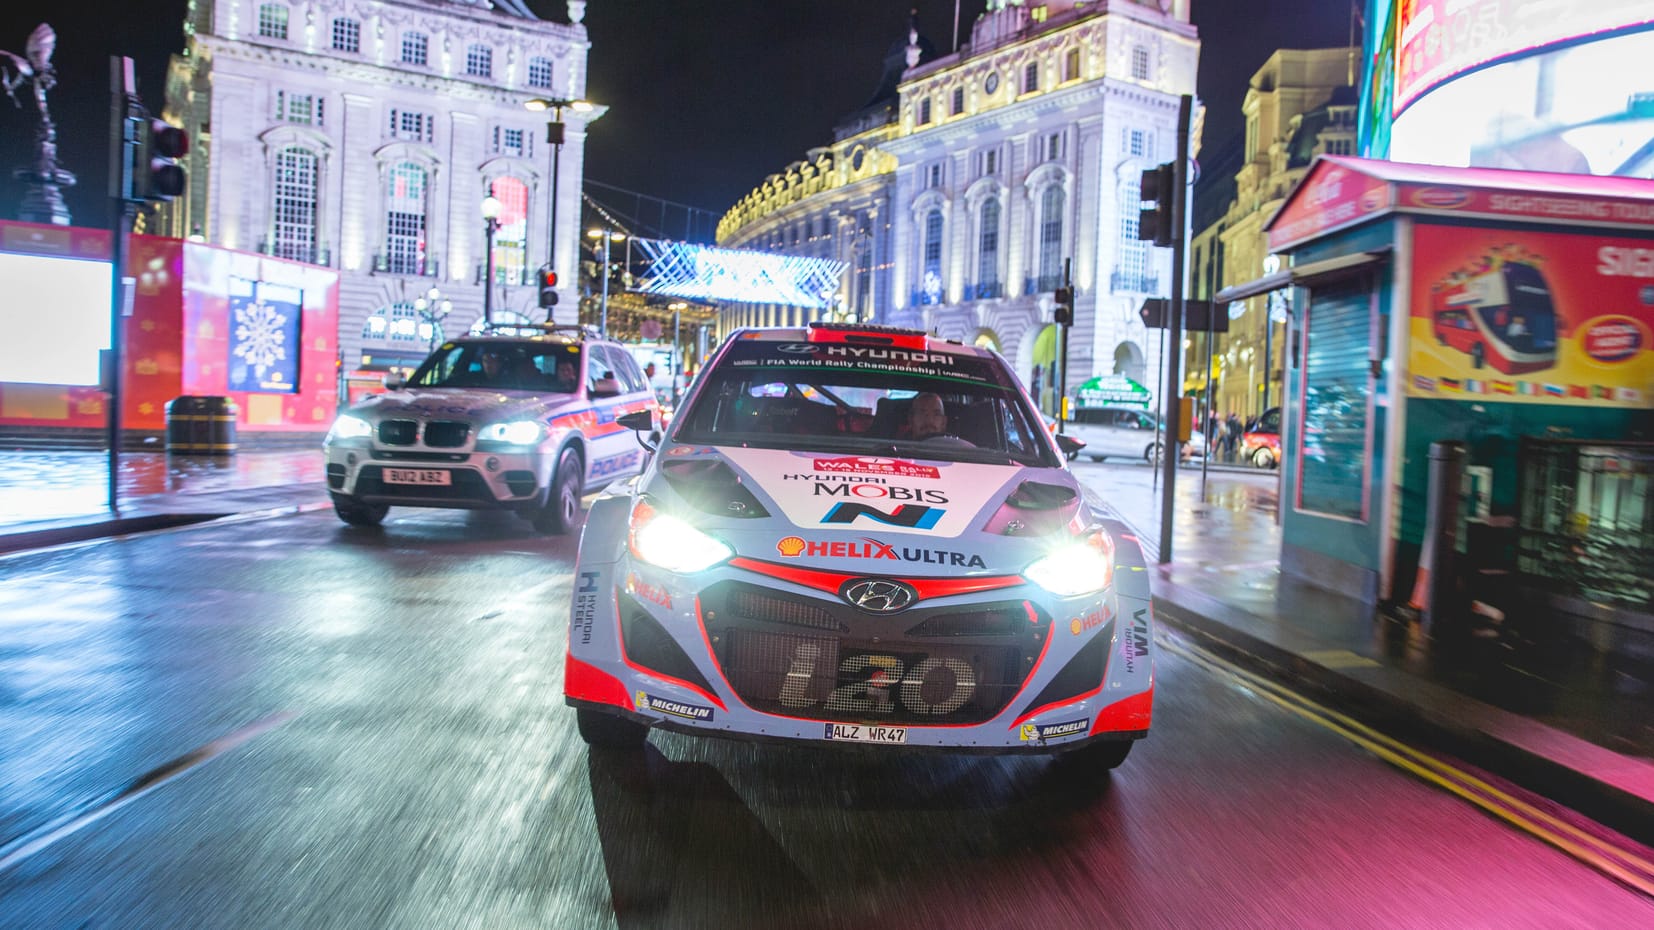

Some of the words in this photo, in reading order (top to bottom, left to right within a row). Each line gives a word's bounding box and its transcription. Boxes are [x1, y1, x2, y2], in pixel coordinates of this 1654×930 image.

[828, 346, 955, 365] HYUNDAI
[789, 359, 822, 367] World
[825, 360, 854, 369] Rally
[857, 361, 936, 375] Championship
[590, 453, 638, 478] POLICE
[817, 461, 895, 472] WALES
[783, 474, 887, 484] HYUNDAI
[813, 482, 950, 504] MOBIS
[807, 538, 899, 560] HELIX
[903, 547, 986, 569] ULTRA
[635, 580, 673, 610] HELIX
[574, 595, 587, 631] STEEL
[582, 594, 597, 645] HYUNDAI
[1125, 628, 1134, 673] HYUNDAI
[778, 642, 977, 714] i20
[651, 698, 710, 718] MICHELIN
[833, 725, 860, 740] ALZ
[1042, 720, 1088, 736] MICHELIN
